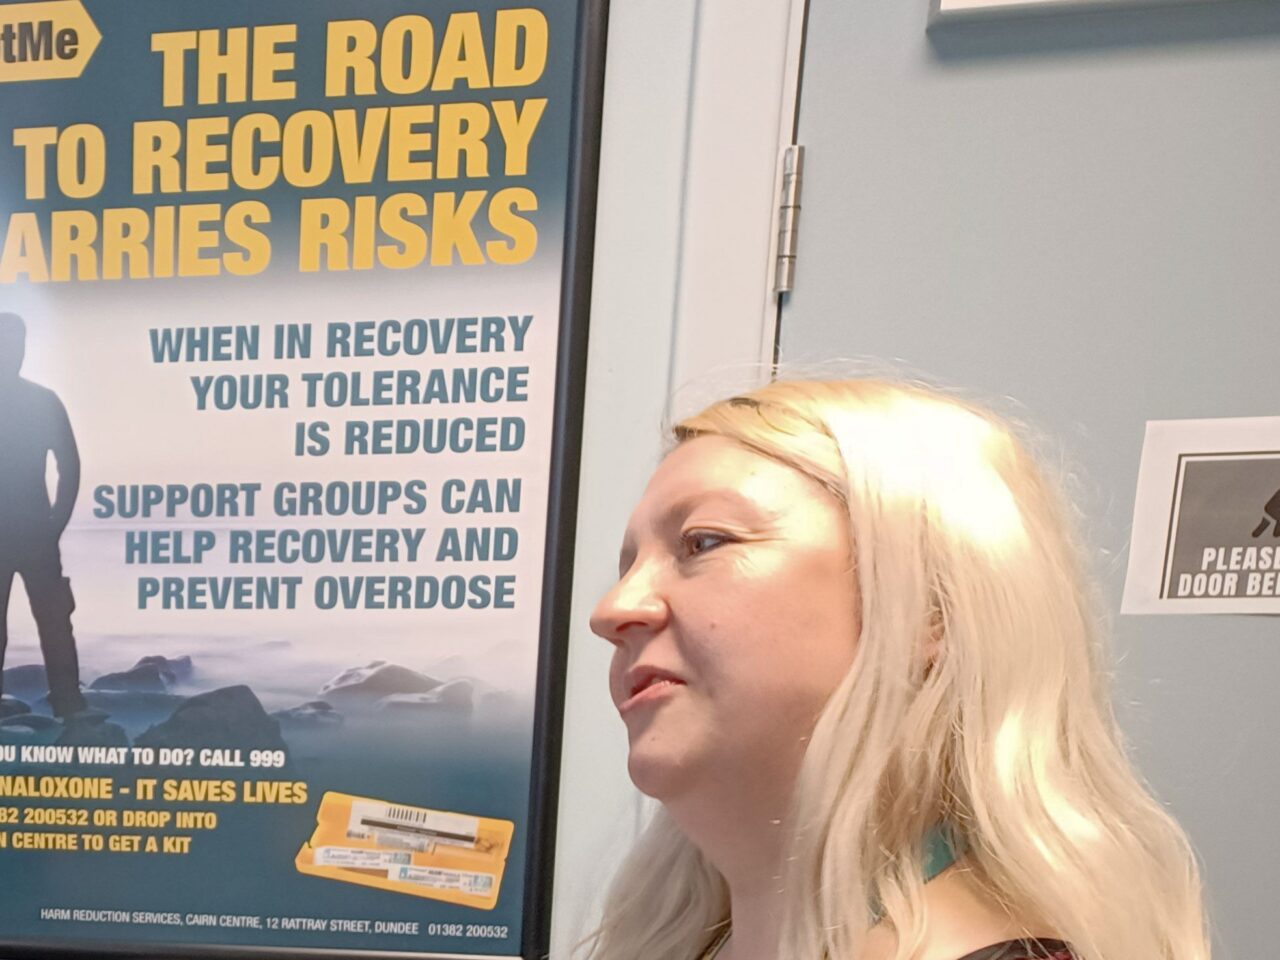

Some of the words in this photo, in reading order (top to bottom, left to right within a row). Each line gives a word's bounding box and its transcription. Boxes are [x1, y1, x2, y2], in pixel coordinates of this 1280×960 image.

[151, 24, 297, 107] THE
[325, 8, 549, 97] ROAD
[13, 123, 107, 200] TO
[132, 98, 548, 195] RECOVERY
[299, 187, 539, 273] RISKS
[149, 324, 260, 363] WHEN
[273, 323, 311, 359] IN
[326, 315, 534, 357] RECOVERY
[190, 373, 289, 411] YOUR
[301, 366, 529, 408] TOLERANCE
[294, 421, 330, 457] IS
[344, 416, 525, 455] REDUCED
[92, 483, 261, 519] SUPPORT
[273, 480, 427, 517] GROUPS
[440, 478, 521, 514] CAN
[124, 531, 216, 565] HELP
[228, 528, 426, 565] RECOVERY
[435, 527, 518, 562] AND
[137, 577, 302, 610] PREVENT
[314, 575, 516, 610] OVERDOSE
[1177, 573, 1238, 597] DOOR
[21, 746, 73, 763] KNOW
[78, 747, 128, 765] WHAT
[132, 748, 154, 764] TO
[159, 748, 194, 766] DO?
[200, 749, 244, 767] CALL
[250, 750, 285, 768] 999
[136, 779, 157, 800] IT
[163, 779, 236, 802] SAVES
[243, 781, 308, 804] LIVES
[24, 807, 88, 826] 200532
[93, 810, 117, 827] OR
[123, 811, 171, 828] DROP
[176, 812, 217, 830] INTO
[12, 832, 78, 850] CENTRE
[82, 834, 104, 851] TO
[108, 835, 141, 852] GET
[145, 836, 158, 852] A
[163, 836, 192, 854] KIT
[40, 908, 70, 920] HARM
[72, 909, 130, 923] REDUCTION
[185, 913, 217, 926] CAIRN
[266, 917, 279, 929] 12
[281, 918, 328, 931] RATTRAY
[374, 921, 419, 935] DUNDEE
[428, 923, 463, 937] 01382
[466, 925, 508, 938] 200532
